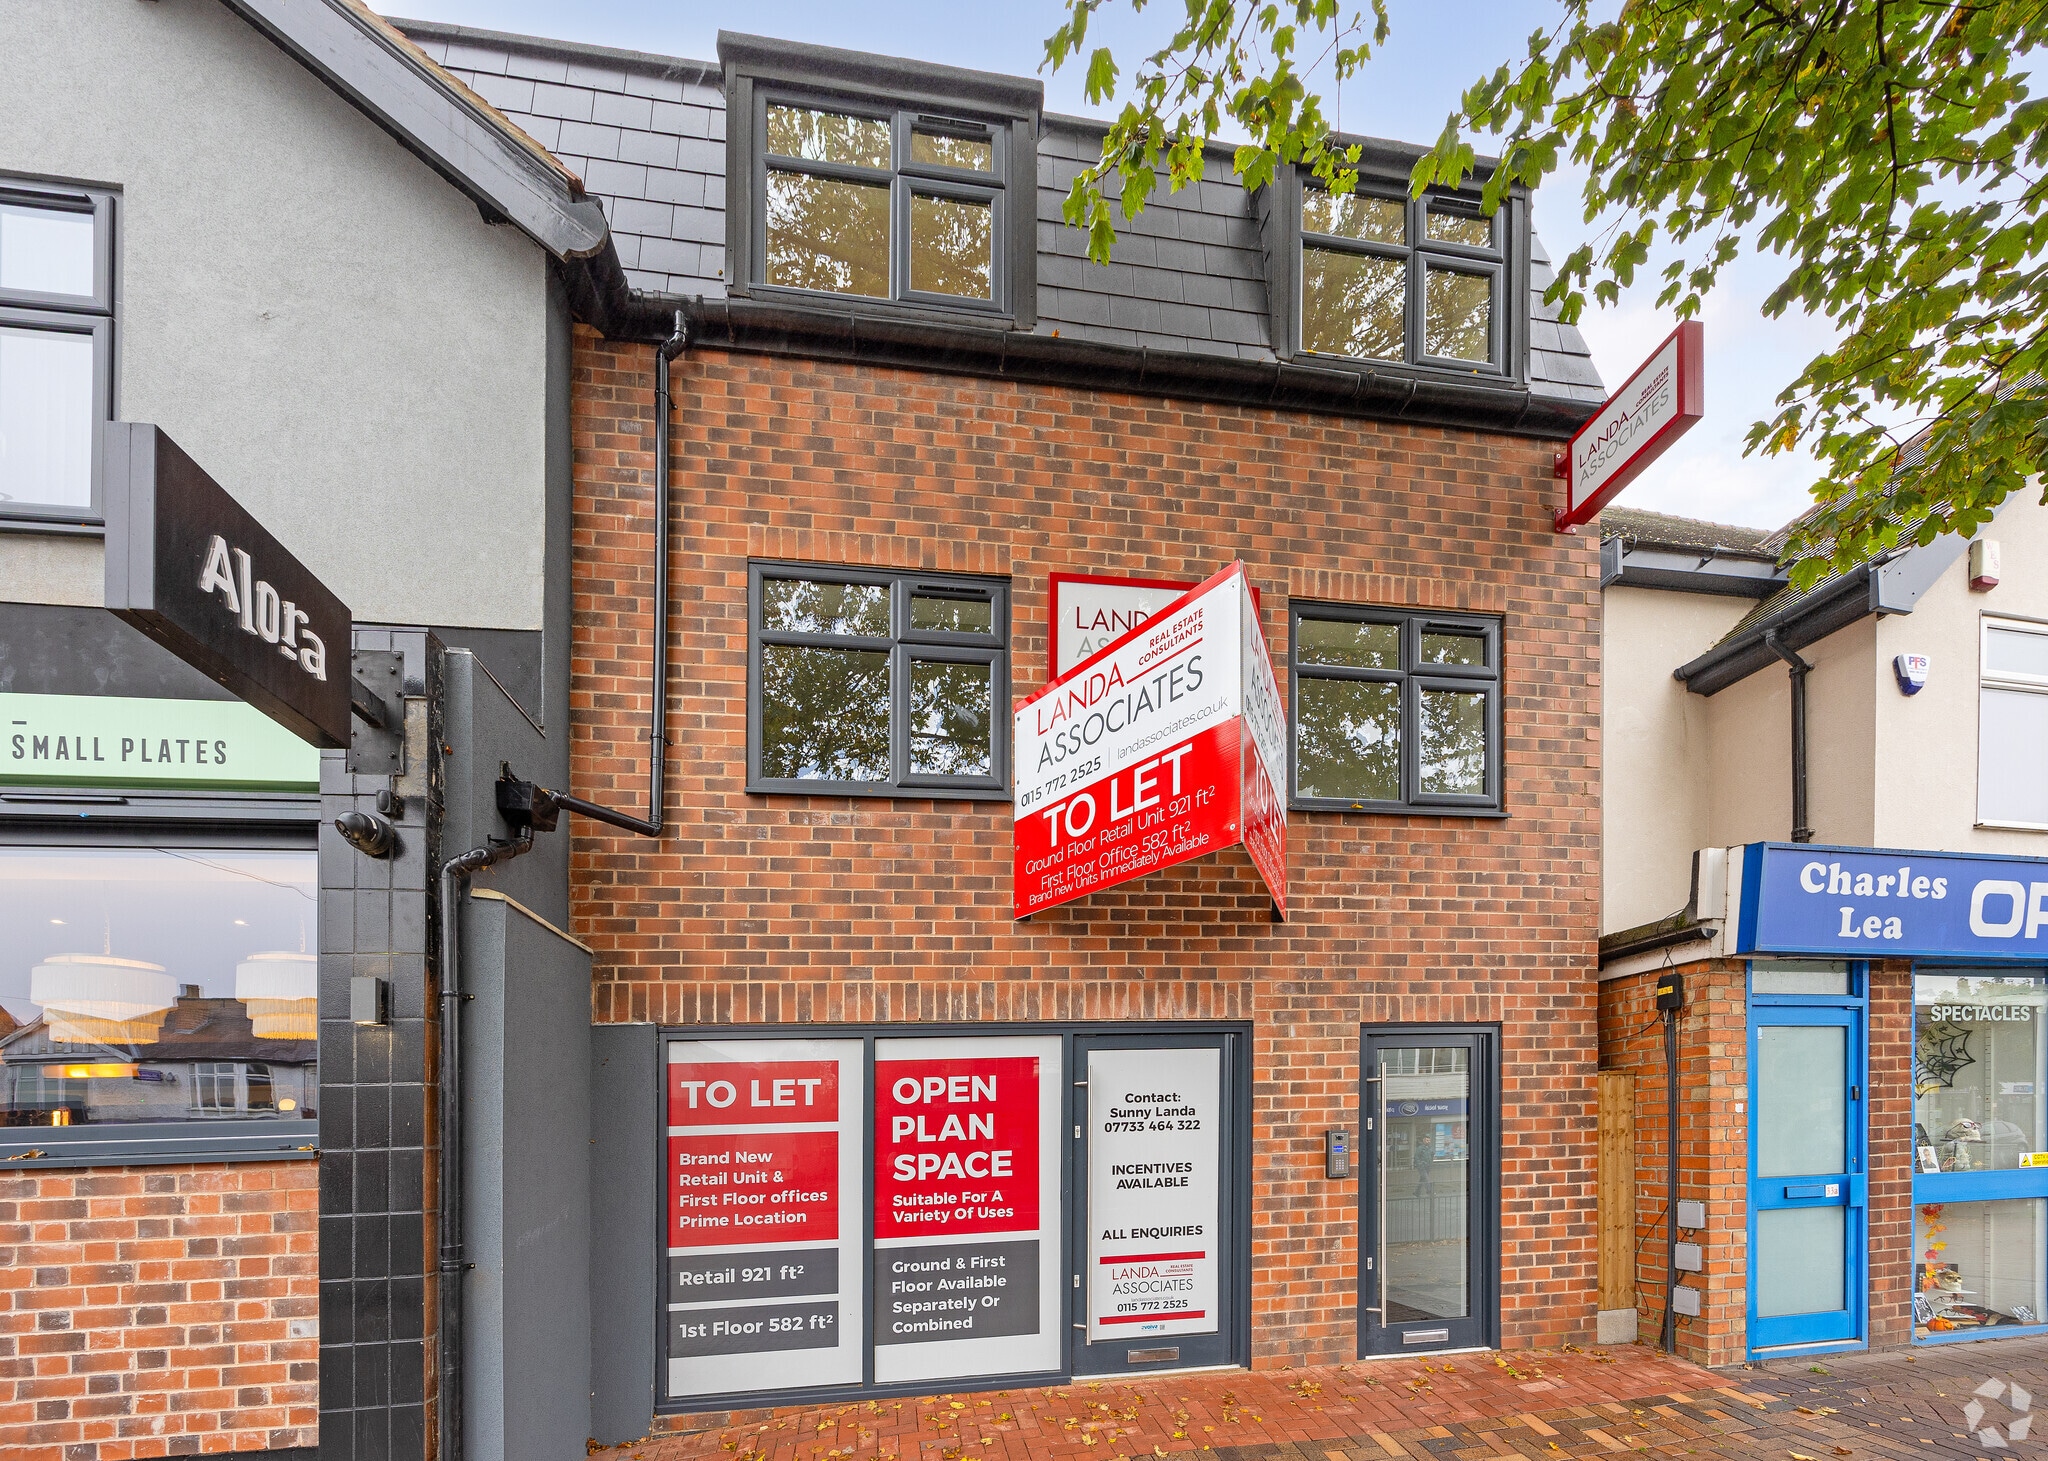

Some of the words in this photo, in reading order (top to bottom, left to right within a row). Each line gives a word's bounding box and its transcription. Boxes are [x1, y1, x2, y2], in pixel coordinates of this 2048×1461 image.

[1579, 388, 1669, 487] ASSOCIATES
[1579, 411, 1630, 468] LANDA
[200, 534, 327, 682] Alora
[1149, 629, 1170, 648] REAL
[1172, 608, 1204, 634] ESTATE
[1138, 620, 1204, 666] CONSULTANTS
[1908, 656, 1927, 669] PFS
[1037, 662, 1125, 736] LANDA
[1037, 655, 1203, 773] ASSOCIATES
[12, 734, 105, 761] SMALL
[122, 737, 227, 765] PLATES
[1021, 787, 1042, 807] 0115
[1046, 774, 1066, 794] 772
[1070, 756, 1101, 782] 2525
[1117, 696, 1228, 760] landassociates.co.uk
[1043, 793, 1096, 848] TO
[1110, 742, 1192, 822] LET
[1253, 746, 1268, 816] TO
[1270, 788, 1283, 853] LET
[1026, 853, 1064, 875] Ground
[1067, 836, 1096, 860] Floor
[1100, 818, 1133, 846] Retail
[1137, 807, 1165, 830] Unit
[1169, 796, 1192, 818] 921
[1029, 889, 1052, 906] Brand
[1054, 884, 1072, 897] new
[1076, 874, 1098, 890] Units
[1100, 852, 1160, 881] Immediately
[1162, 832, 1209, 859] Available
[1041, 869, 1064, 891] First
[1066, 858, 1096, 881] Floor
[1099, 844, 1138, 869] Office
[1142, 830, 1168, 853] 582
[1800, 861, 1948, 901] Charles
[1838, 907, 1903, 940] Lea
[1930, 1005, 2031, 1022] SPECTACLES
[680, 1080, 736, 1109] TO
[750, 1078, 822, 1108] LET
[892, 1074, 997, 1105] OPEN
[1124, 1092, 1181, 1104] Contact:
[1110, 1107, 1152, 1121] Sunny
[1156, 1106, 1196, 1118] Landa
[892, 1113, 994, 1144] PLAN
[1104, 1120, 1145, 1133] 07733
[1148, 1120, 1174, 1132] 464
[1177, 1120, 1200, 1130] 322
[679, 1152, 730, 1166] Brand
[735, 1150, 773, 1164] New
[892, 1150, 1013, 1182] SPACE
[679, 1172, 728, 1187] Retail
[733, 1170, 768, 1184] Unit
[772, 1170, 784, 1183] &
[1111, 1162, 1192, 1176] INCENTIVES
[1116, 1176, 1189, 1190] AVAILABLE
[679, 1193, 718, 1208] First
[722, 1191, 766, 1205] Floor
[770, 1189, 828, 1204] offices
[892, 1192, 957, 1208] Suitable
[962, 1191, 988, 1204] For
[991, 1190, 1004, 1202] A
[679, 1214, 729, 1228] Prime
[734, 1211, 807, 1226] Location
[892, 1208, 950, 1224] Variety
[954, 1206, 974, 1220] Of
[978, 1206, 1014, 1219] Uses
[1102, 1228, 1126, 1240] ALL
[1131, 1225, 1203, 1240] ENQUIRIES
[892, 1258, 951, 1273] Ground
[956, 1258, 966, 1270] &
[970, 1255, 1006, 1268] First
[1112, 1266, 1160, 1280] LANDA
[679, 1268, 735, 1286] Retail
[742, 1267, 772, 1282] 921
[892, 1279, 933, 1294] Floor
[937, 1275, 1006, 1291] Available
[1112, 1278, 1194, 1296] ASSOCIATES
[892, 1296, 977, 1315] Separately
[981, 1294, 1000, 1308] Or
[1117, 1302, 1138, 1312] 0115
[1140, 1301, 1160, 1310] 772
[1163, 1300, 1188, 1309] 2525
[679, 1322, 706, 1338] 1st
[712, 1319, 764, 1336] Floor
[768, 1316, 804, 1332] 582
[892, 1316, 973, 1334] Combined
